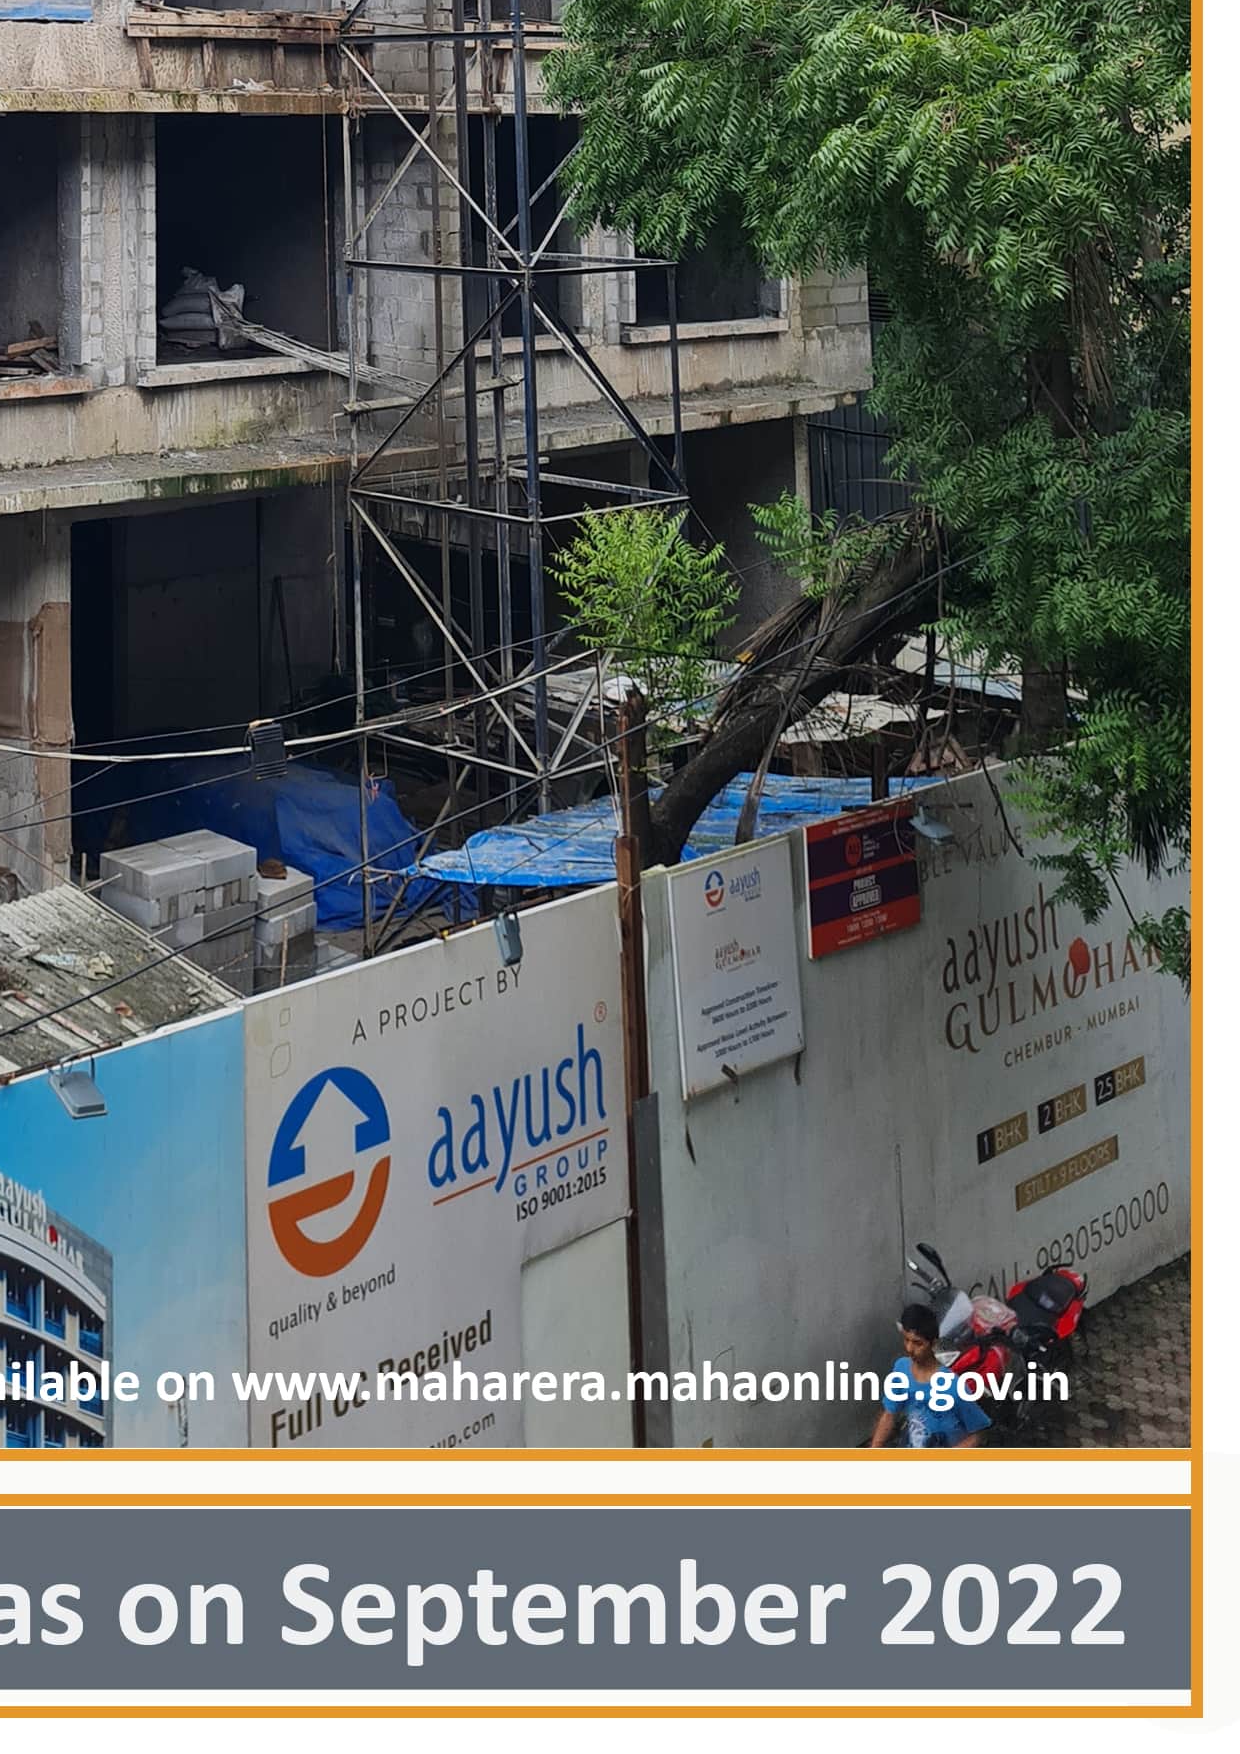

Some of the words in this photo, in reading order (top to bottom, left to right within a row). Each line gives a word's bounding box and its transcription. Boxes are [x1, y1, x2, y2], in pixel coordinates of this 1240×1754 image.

[941, 881, 1061, 997] aayush
[351, 1018, 368, 1045] A
[378, 977, 486, 1036] PROJECT
[496, 965, 522, 994] BY
[1003, 1025, 1073, 1068] CHEMBUR
[1086, 996, 1140, 1031] MUMBAI
[427, 1022, 607, 1193] aayush
[994, 1117, 1024, 1152] BHK
[1042, 1104, 1052, 1127] 2
[1054, 1090, 1083, 1122] BHK
[1114, 1061, 1142, 1092] BHK
[514, 1139, 608, 1196] GROUP
[516, 1196, 539, 1222] ISO
[541, 1166, 607, 1205] 9001:2015
[1035, 1181, 1170, 1271] 9930550000
[268, 1301, 322, 1340] quality
[326, 1292, 338, 1313] &
[342, 1263, 396, 1305] beyond
[377, 1309, 492, 1391] Received
